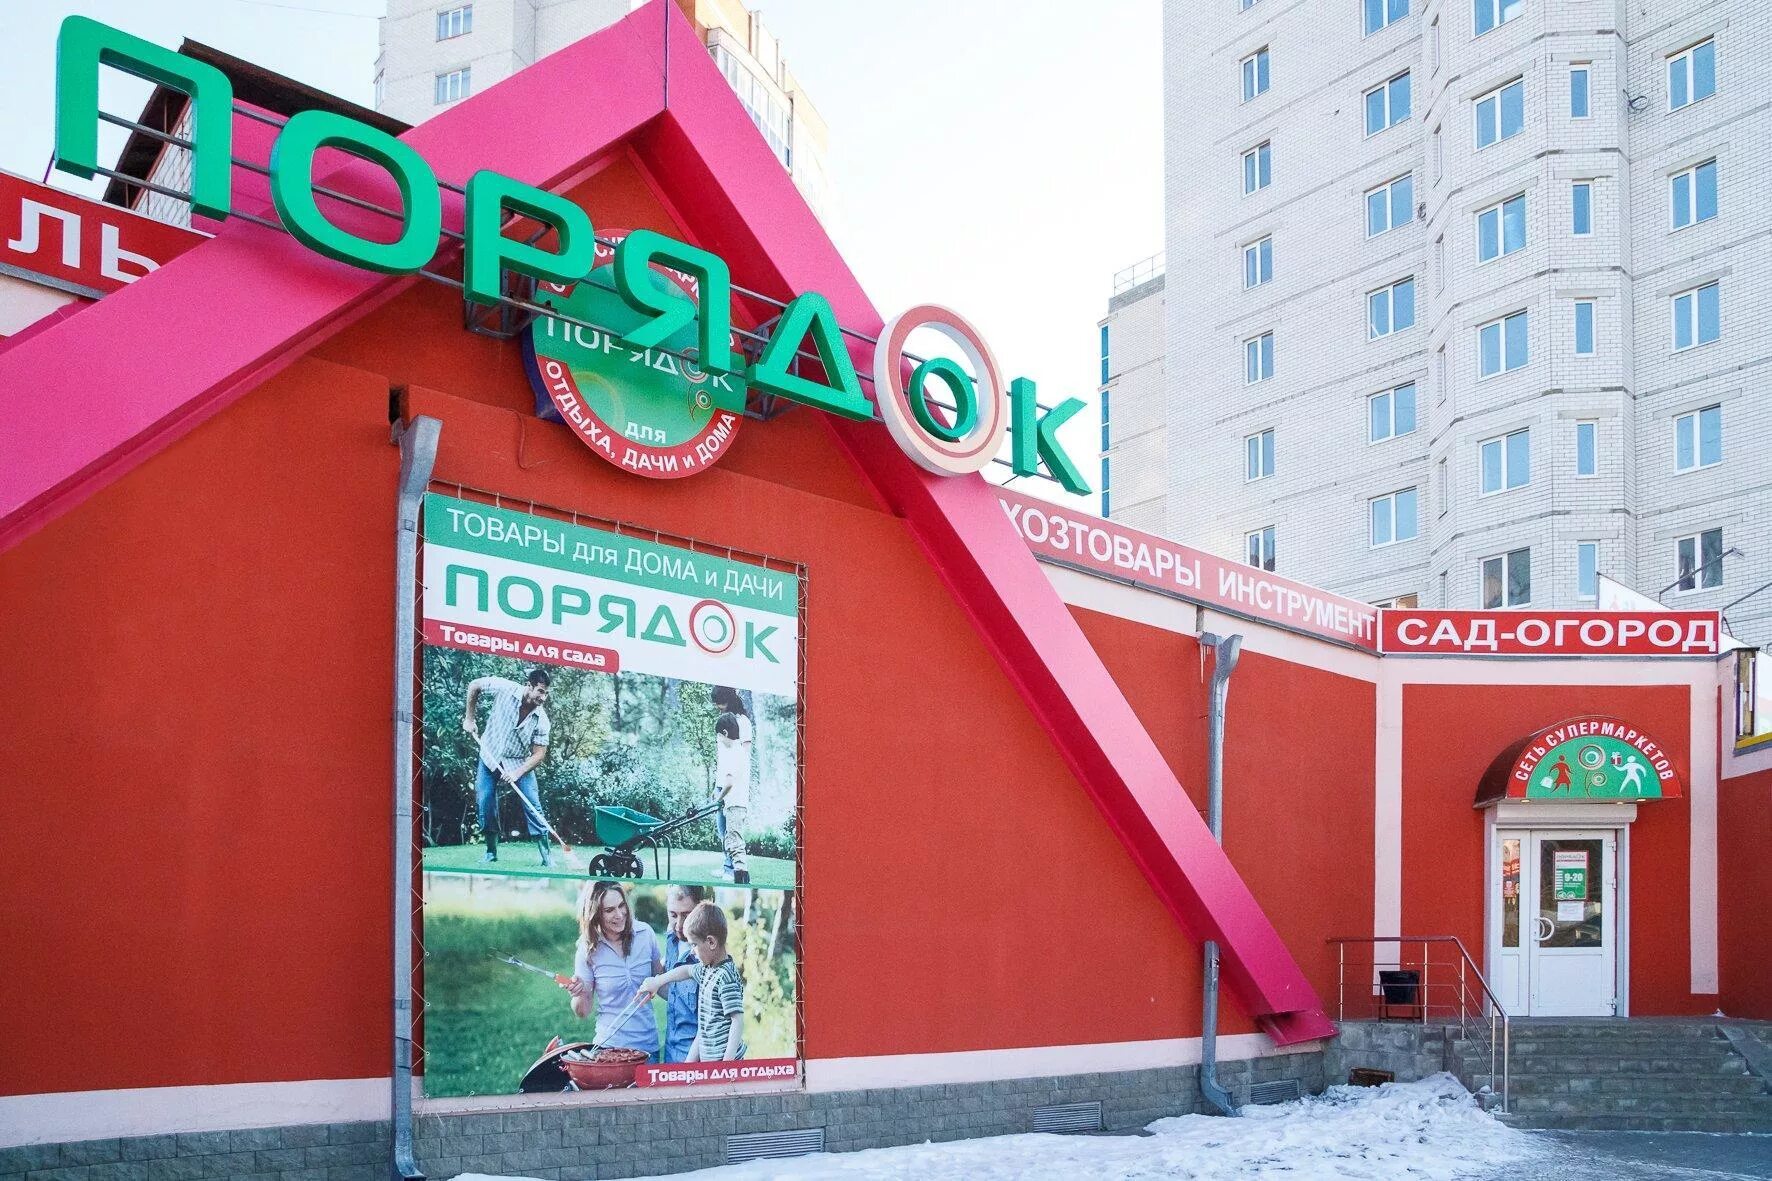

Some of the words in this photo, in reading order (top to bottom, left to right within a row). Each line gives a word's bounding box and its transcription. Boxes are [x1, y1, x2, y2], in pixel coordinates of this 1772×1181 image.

[8, 198, 161, 284] ЛЬ
[55, 15, 1092, 496] ПОРЯДОК
[545, 361, 615, 459] ОТДЫХА,
[622, 448, 678, 472] ДАЧИ
[695, 413, 736, 465] ДОМА
[446, 507, 565, 555] ТОВАРЫ
[572, 541, 618, 567] для
[624, 546, 698, 583] ДОМА
[705, 571, 718, 587] и
[723, 569, 784, 601] ДАЧИ
[999, 498, 1200, 590] ХОЗТОВАРЫ
[1219, 567, 1376, 641] ИНСТРУМЕНТ
[440, 624, 520, 653] Товары
[523, 642, 559, 659] для
[562, 649, 605, 666] сада
[445, 564, 781, 664] ПОРЯДОК
[1397, 619, 1717, 652] САД-ОГОРОД
[1515, 746, 1545, 781] СЕТЬ
[1546, 722, 1674, 780] СУПЕРМАРКЕТОВ
[648, 1069, 708, 1083] Товары
[710, 1068, 738, 1079] для
[741, 1065, 795, 1077] отдыха
